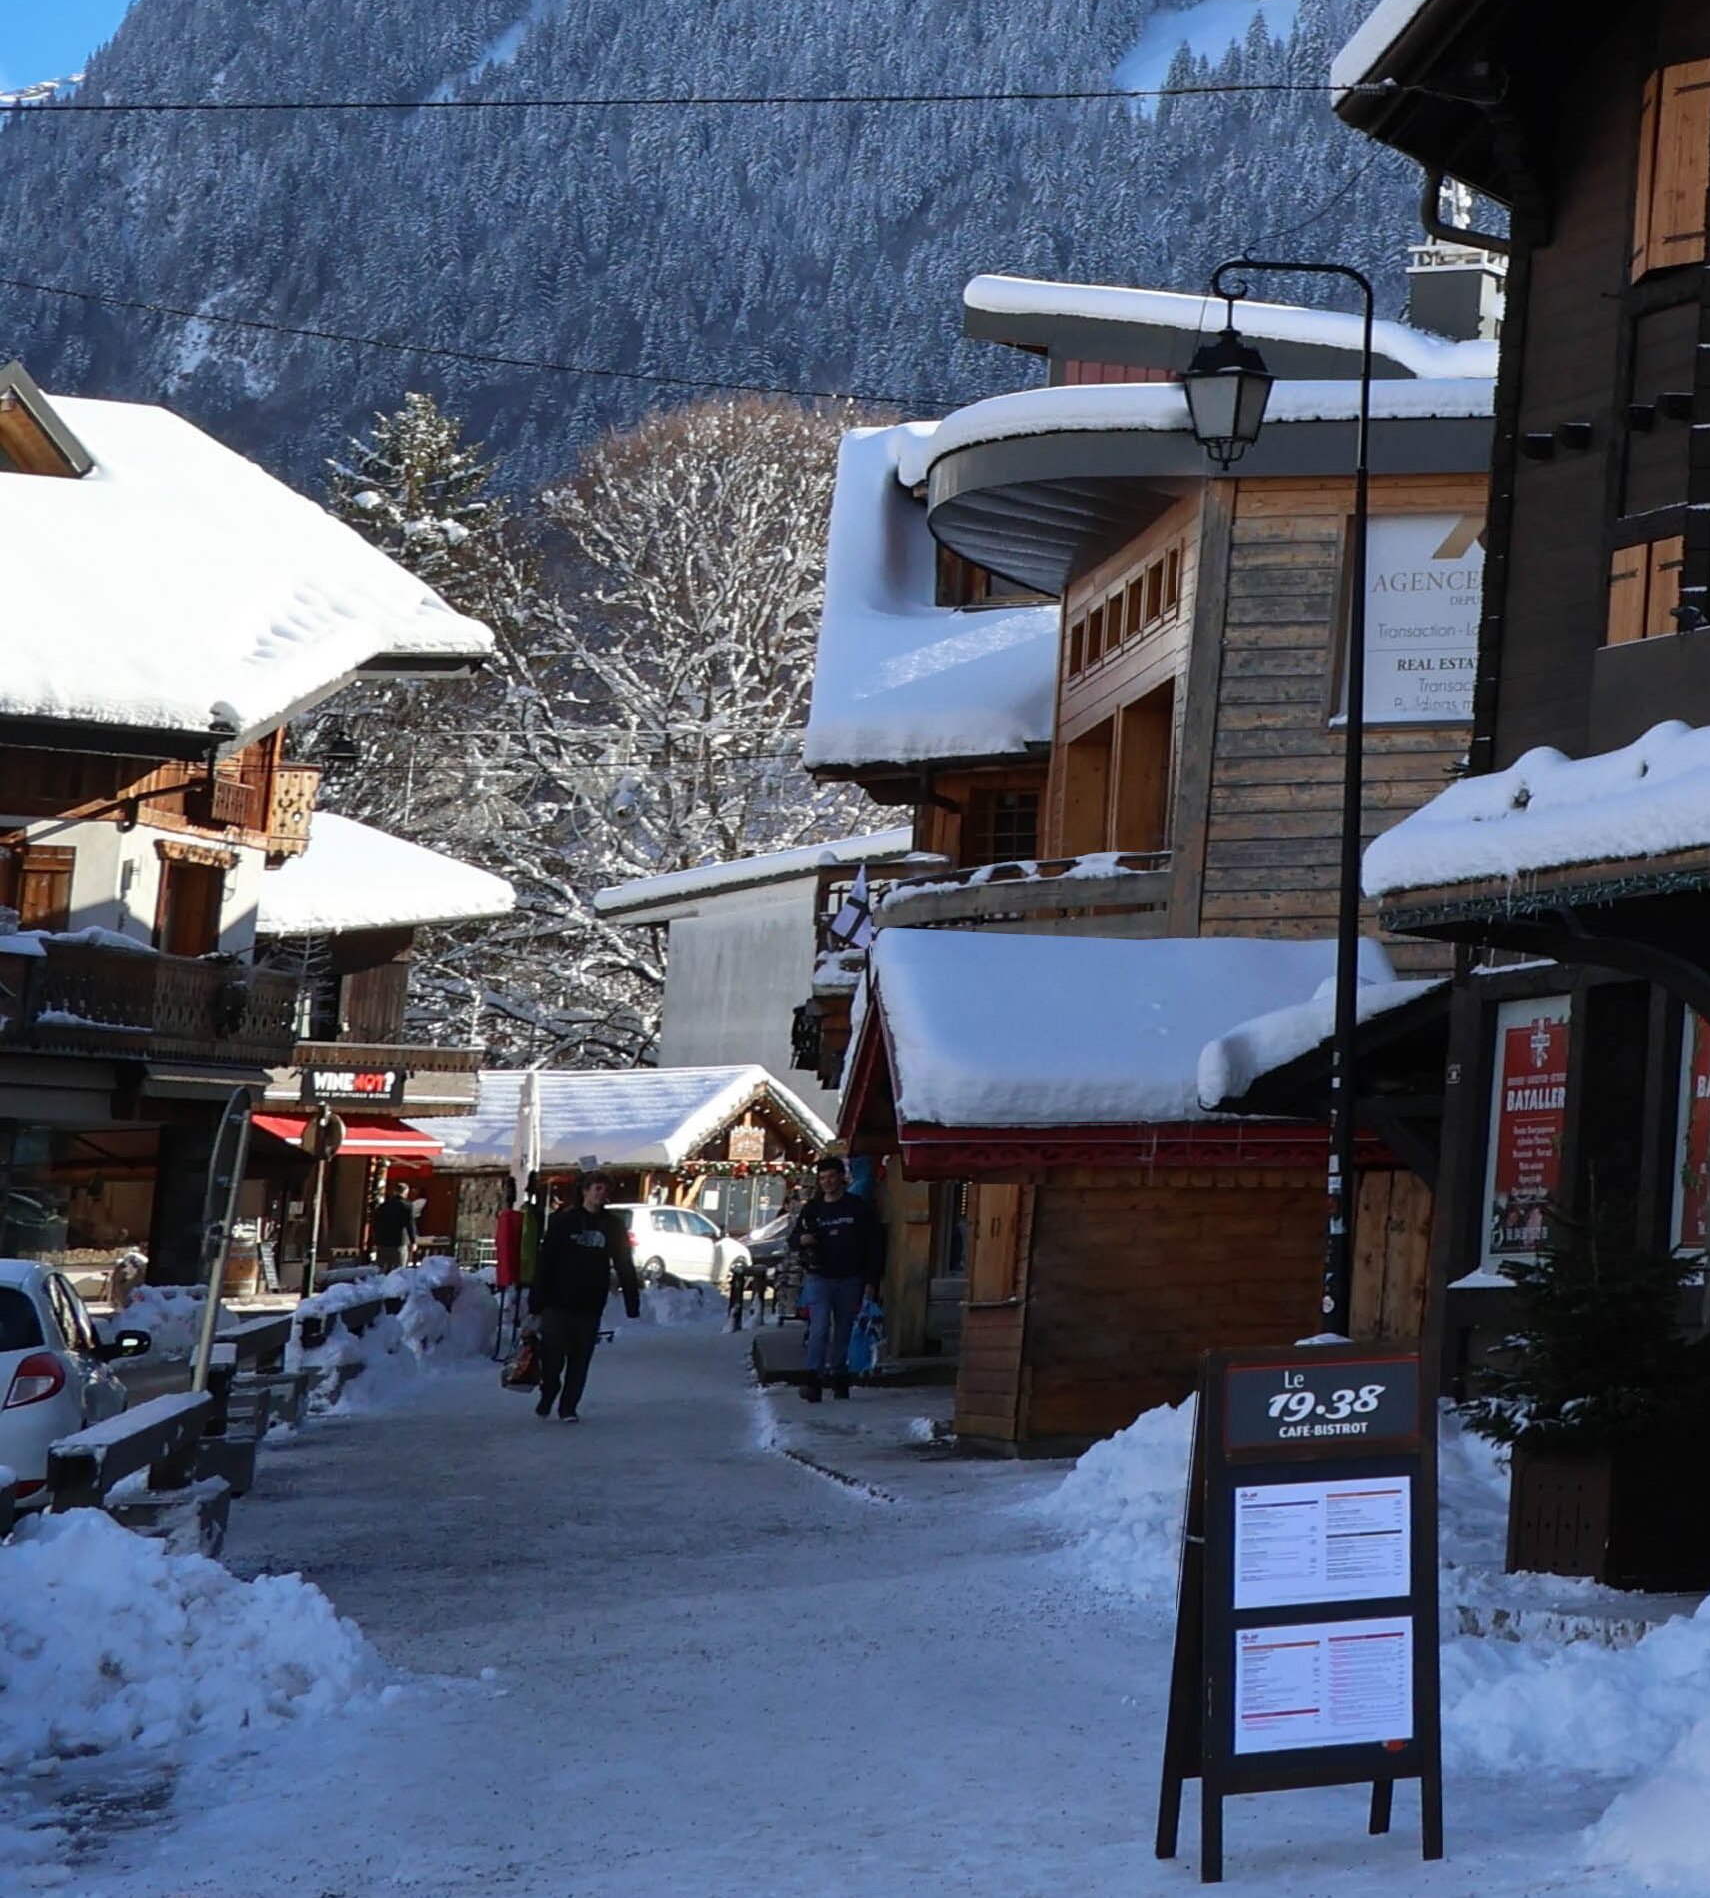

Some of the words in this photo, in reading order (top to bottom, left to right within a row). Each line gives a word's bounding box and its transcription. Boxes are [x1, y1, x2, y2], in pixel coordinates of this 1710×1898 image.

[1370, 570, 1481, 593] AGENCE
[1377, 622, 1456, 639] Transaction
[1396, 658, 1435, 672] REAL
[1439, 657, 1478, 671] ESTA
[1418, 677, 1476, 694] Transac
[1506, 1086, 1566, 1112] BATALLER
[1284, 1370, 1305, 1389] Le
[1267, 1384, 1387, 1423] 19.38
[1278, 1421, 1369, 1439] CAFÉ-BISTROT
